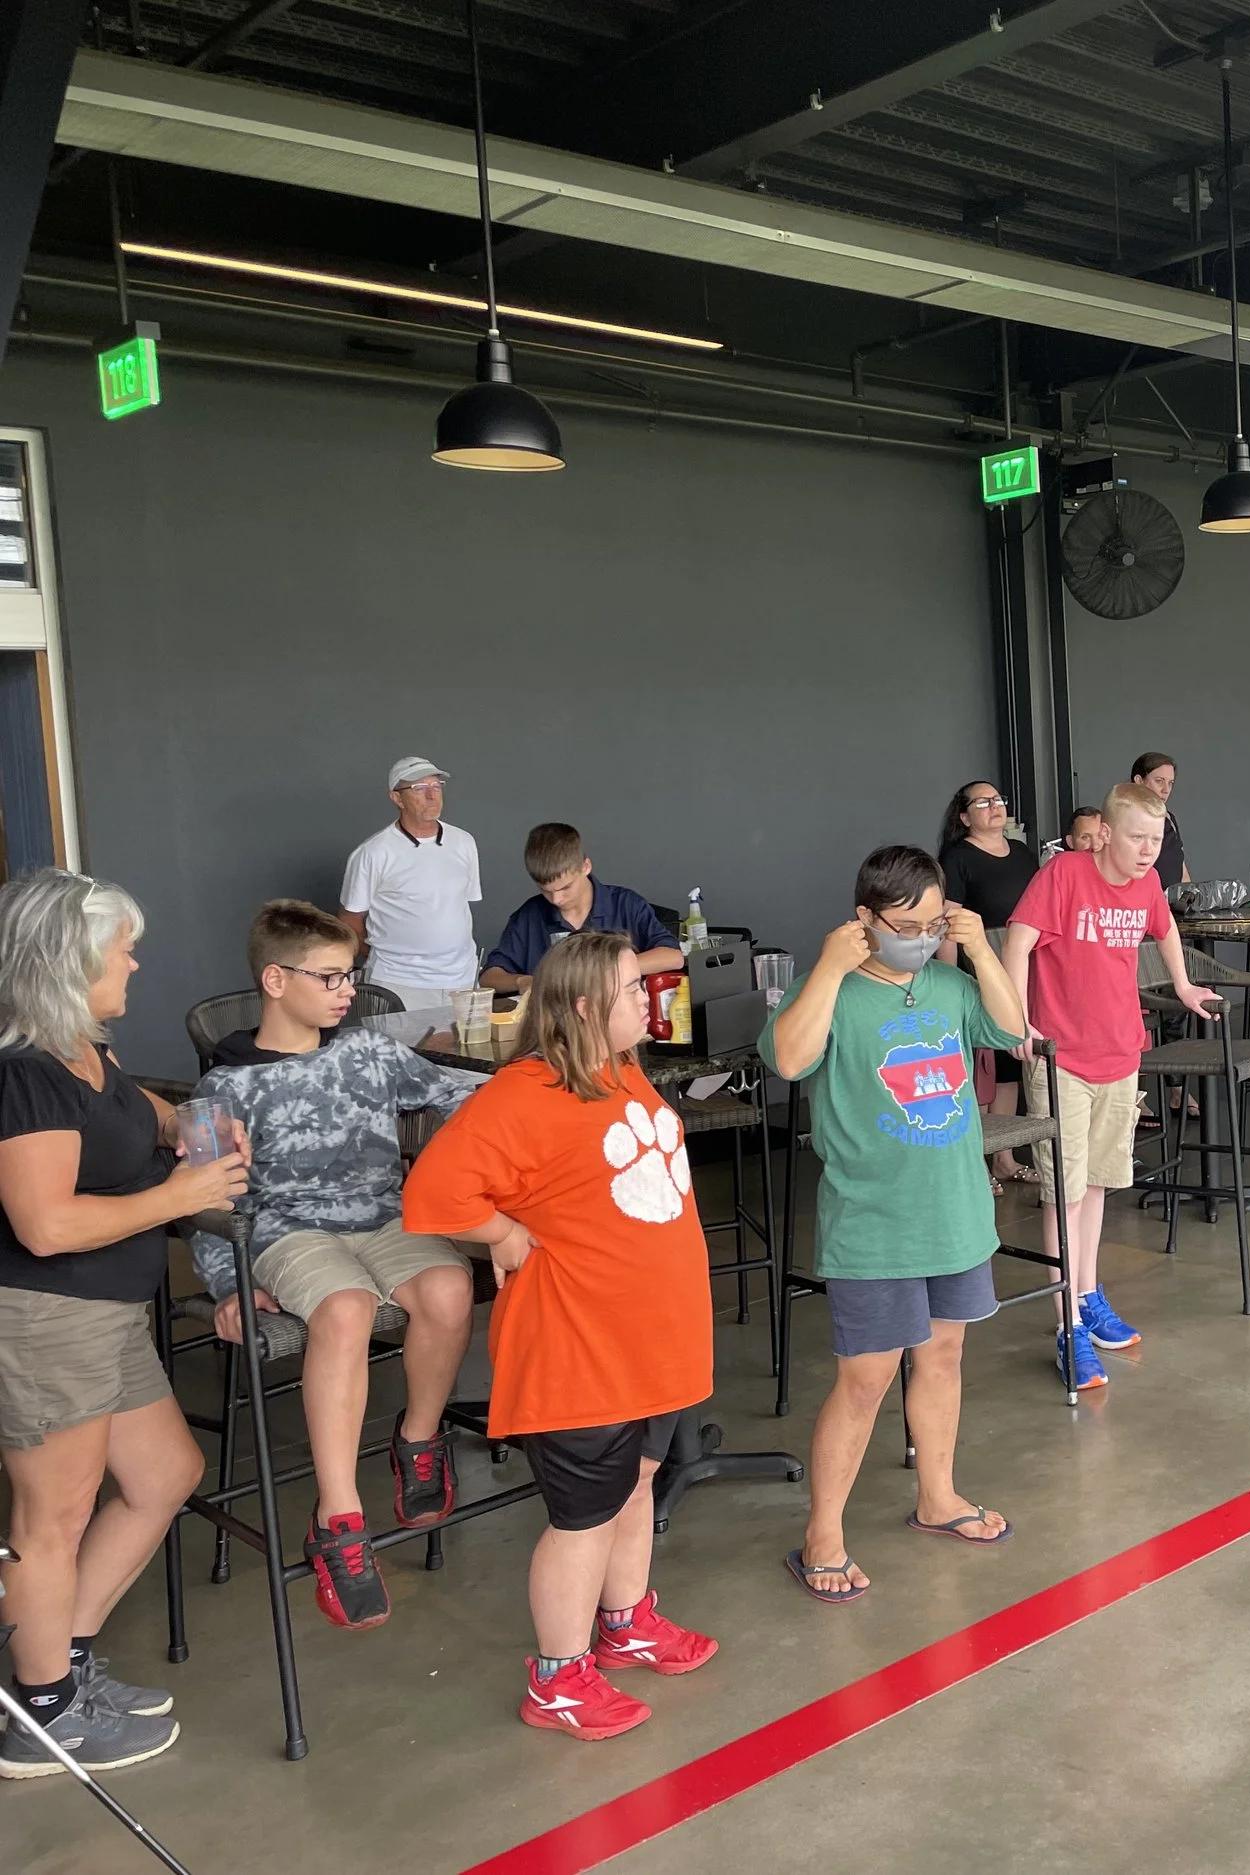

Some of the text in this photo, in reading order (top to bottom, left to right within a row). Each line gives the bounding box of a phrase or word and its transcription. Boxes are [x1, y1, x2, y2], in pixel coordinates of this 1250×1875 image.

[108, 354, 137, 399] 118
[991, 457, 1025, 489] 117
[1106, 938, 1123, 948] GIFTS
[1123, 939, 1131, 948] TO
[1122, 930, 1131, 938] MY
[877, 1098, 971, 1149] CAMBO
